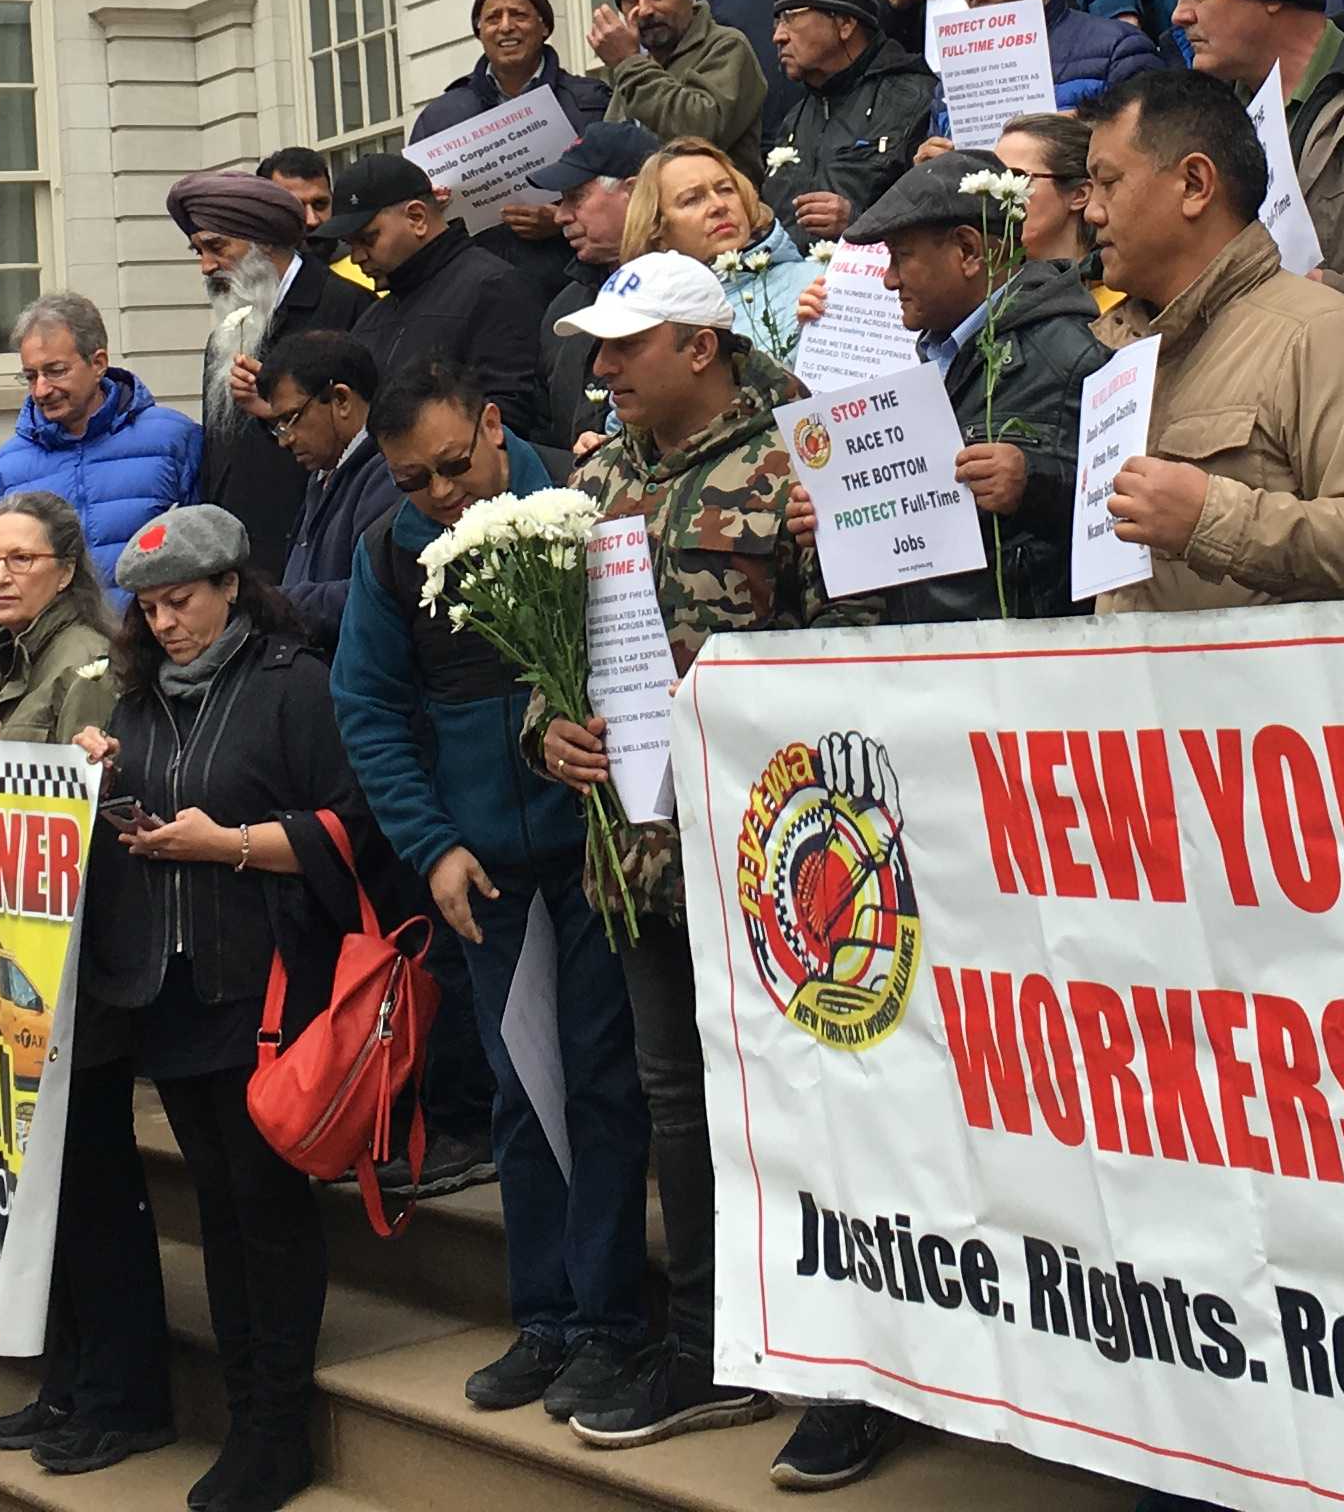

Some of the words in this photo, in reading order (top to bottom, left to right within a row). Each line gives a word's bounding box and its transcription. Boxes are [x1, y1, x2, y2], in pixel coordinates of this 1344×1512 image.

[938, 18, 984, 38] PROTECT
[988, 14, 1016, 28] OUR
[942, 39, 993, 58] FULL-TIME
[998, 32, 1037, 49] JOBS!
[426, 147, 442, 159] WE
[443, 135, 471, 152] WILL
[472, 107, 534, 139] REMEMBER
[428, 160, 458, 177] Danilo
[460, 137, 506, 164] Corporan
[508, 119, 548, 141] Castillo
[461, 161, 498, 182] Alfredo
[499, 146, 530, 164] Perez
[462, 177, 503, 197] Douglas
[504, 157, 546, 179] Schifter
[472, 189, 512, 209] Nicanor
[831, 399, 867, 423] STOP
[870, 390, 899, 412] THE
[846, 431, 883, 455] RACE
[885, 426, 904, 446] TO
[841, 473, 870, 491] THE
[873, 456, 927, 484] BOTTOM
[834, 501, 898, 530] PROTECT
[901, 488, 961, 515] Full-Time
[892, 534, 925, 555] Jobs
[738, 742, 815, 920] nytwa
[969, 728, 1187, 904] NEW
[794, 1000, 818, 1030] NEW
[893, 925, 915, 1000] ALLIANCE
[797, 1191, 1014, 1323] Justice.
[1030, 1234, 1269, 1382] Rights.
